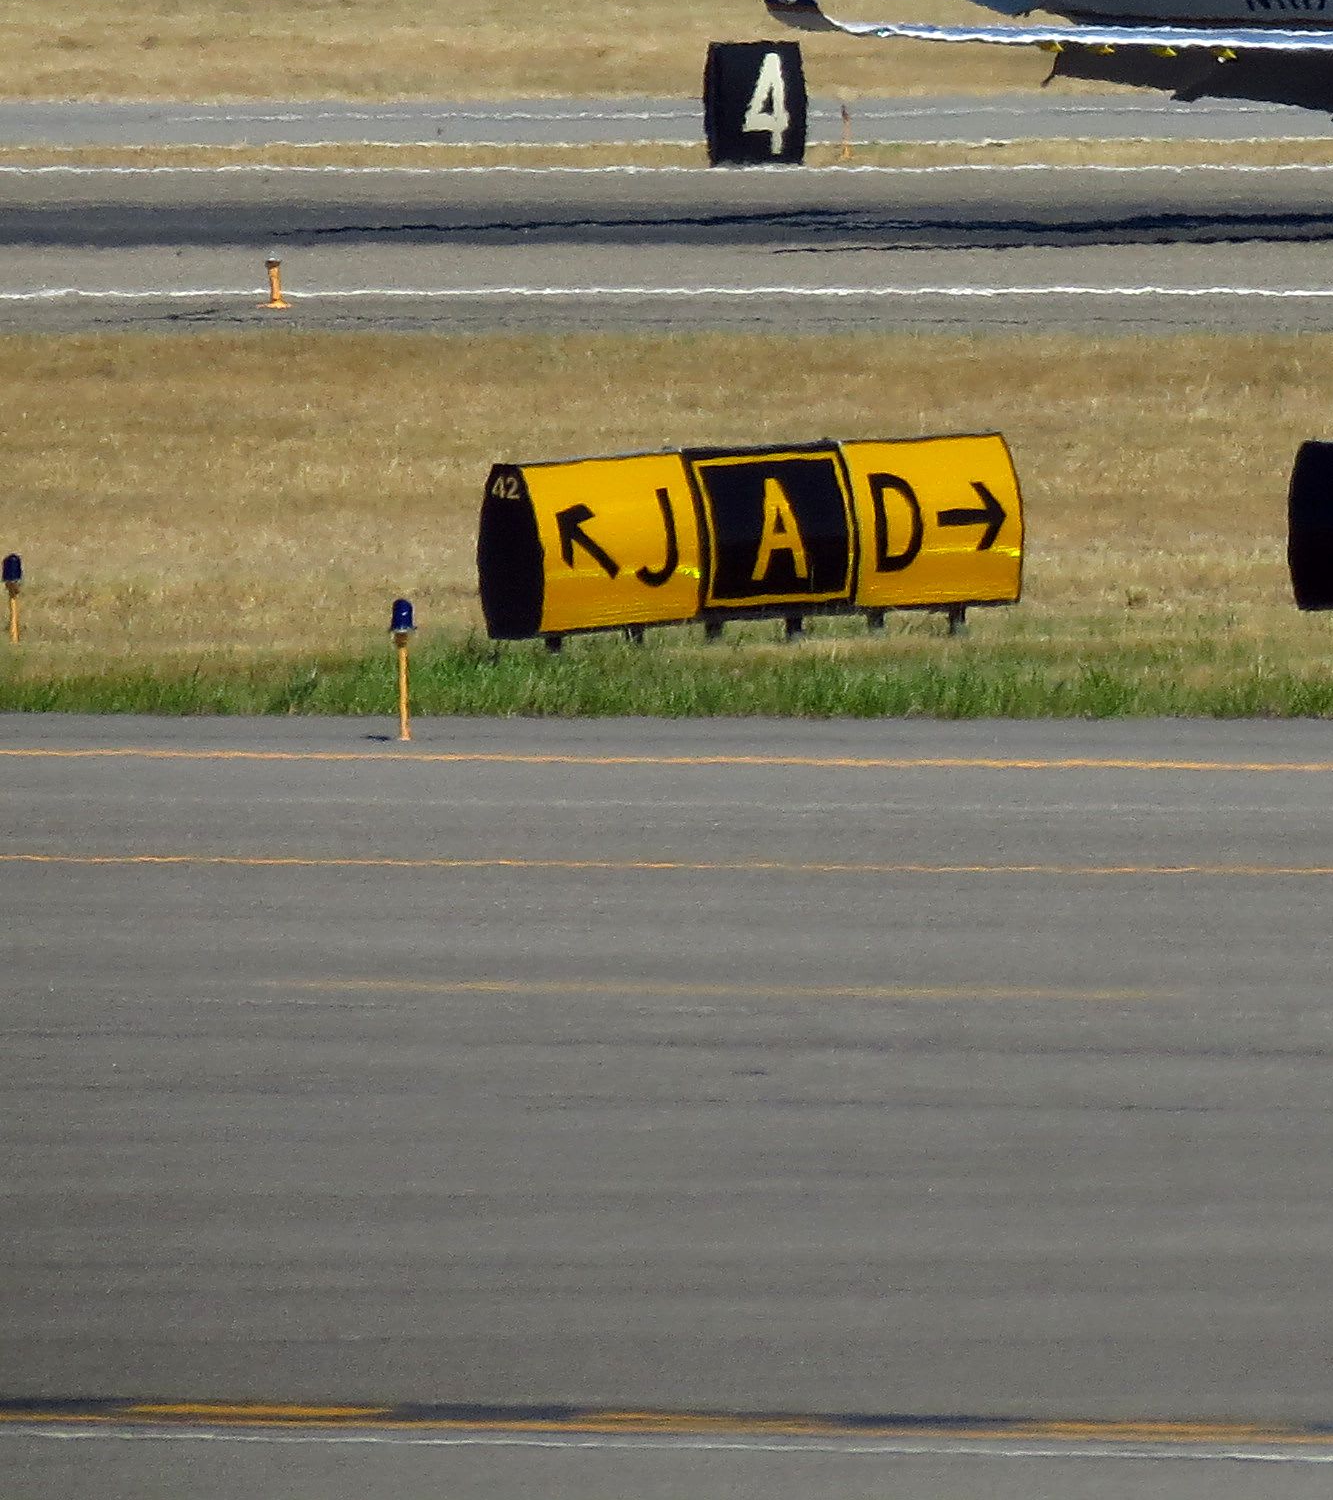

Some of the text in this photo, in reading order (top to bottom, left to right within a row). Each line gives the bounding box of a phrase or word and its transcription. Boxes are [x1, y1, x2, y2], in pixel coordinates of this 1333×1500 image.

[742, 52, 790, 155] 4
[491, 476, 520, 499] 42
[636, 472, 924, 587] J A D
